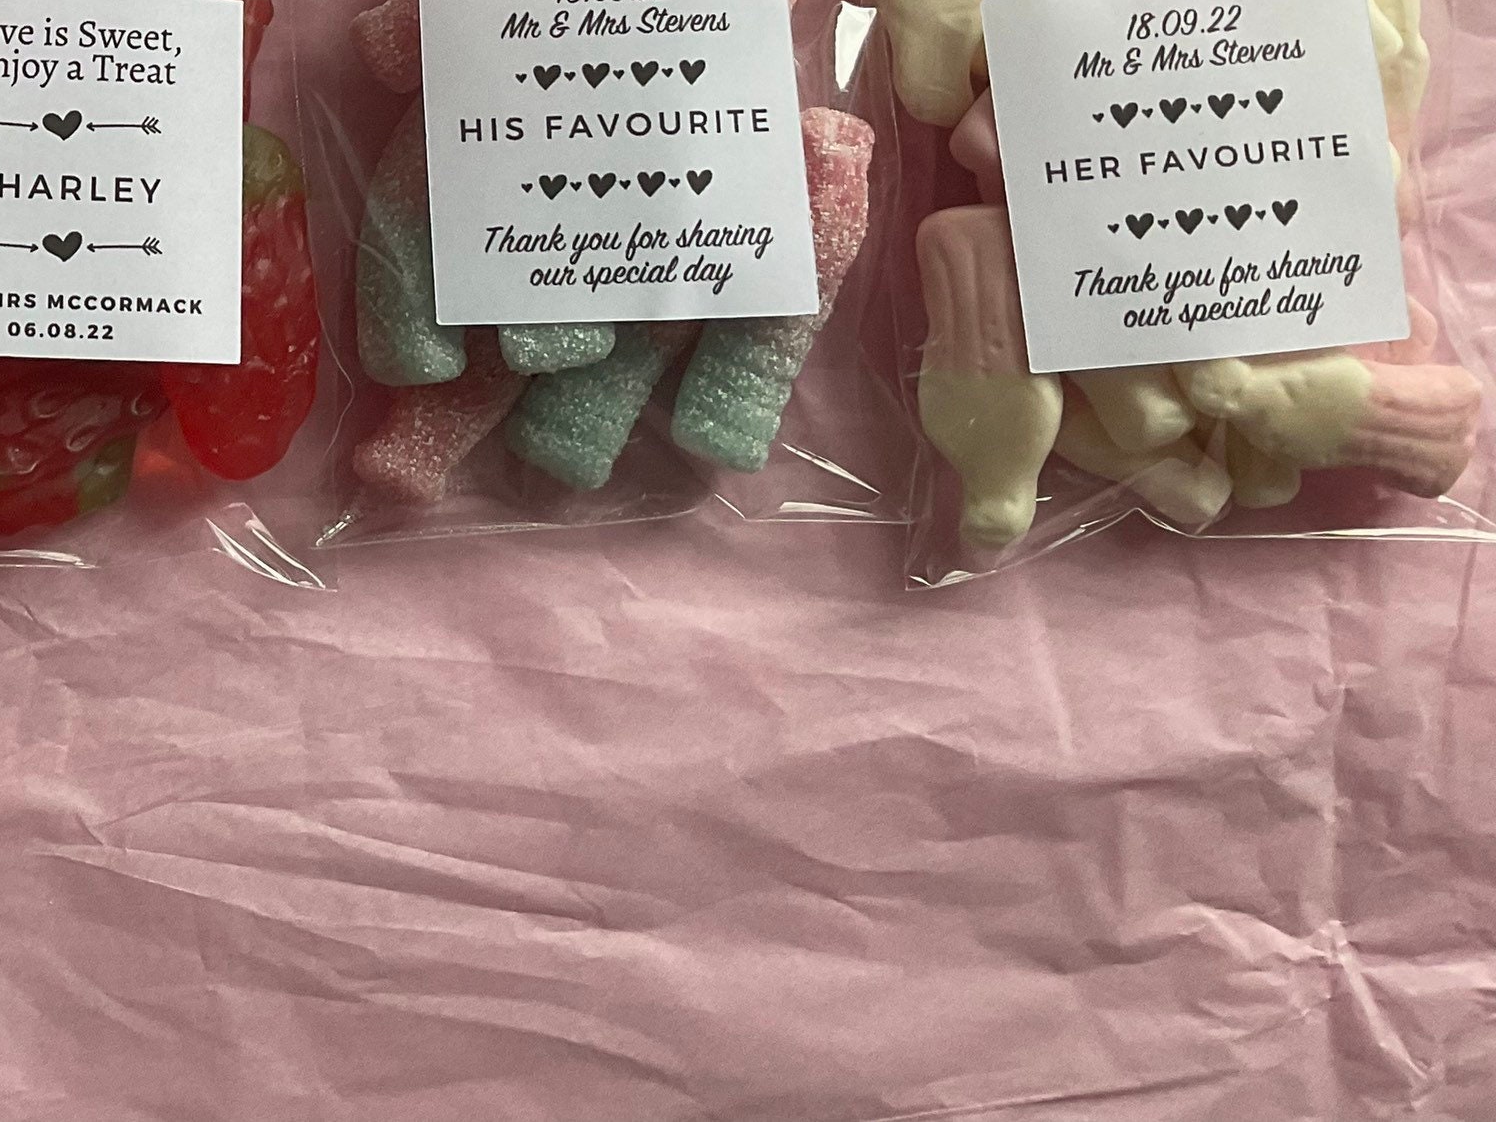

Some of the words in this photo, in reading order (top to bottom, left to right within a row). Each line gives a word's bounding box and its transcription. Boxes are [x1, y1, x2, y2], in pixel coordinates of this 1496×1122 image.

[43, 17, 68, 47] is
[78, 20, 181, 58] Sweet,
[500, 11, 542, 40] Mr
[549, 10, 571, 39] &
[577, 8, 632, 37] Mrs
[635, 6, 731, 34] Stevens
[1126, 4, 1242, 41] 18.09.22
[66, 60, 85, 81] a
[92, 54, 176, 86] Treat
[1073, 50, 1115, 80] Mr
[1122, 47, 1143, 76] &
[1151, 43, 1204, 72] Mrs
[1209, 38, 1306, 66] Stevens
[459, 117, 524, 143] HIS
[545, 108, 770, 140] FAVOURITE
[1045, 156, 1121, 184] HER
[1139, 134, 1350, 176] FAVOURITE
[484, 222, 567, 254] Thank
[569, 231, 623, 266] you
[625, 221, 670, 262] for
[675, 218, 774, 260] sharing
[529, 265, 577, 287] our
[582, 255, 679, 293] special
[683, 254, 734, 296] day
[1074, 262, 1159, 298] Thank
[1163, 268, 1215, 305] you
[1219, 256, 1261, 297] for
[1266, 249, 1362, 287] sharing
[47, 294, 202, 315] MCCORMACK
[1123, 305, 1173, 328] our
[1178, 287, 1271, 332] special
[1276, 285, 1324, 326] day
[7, 321, 114, 340] 06.08.22
